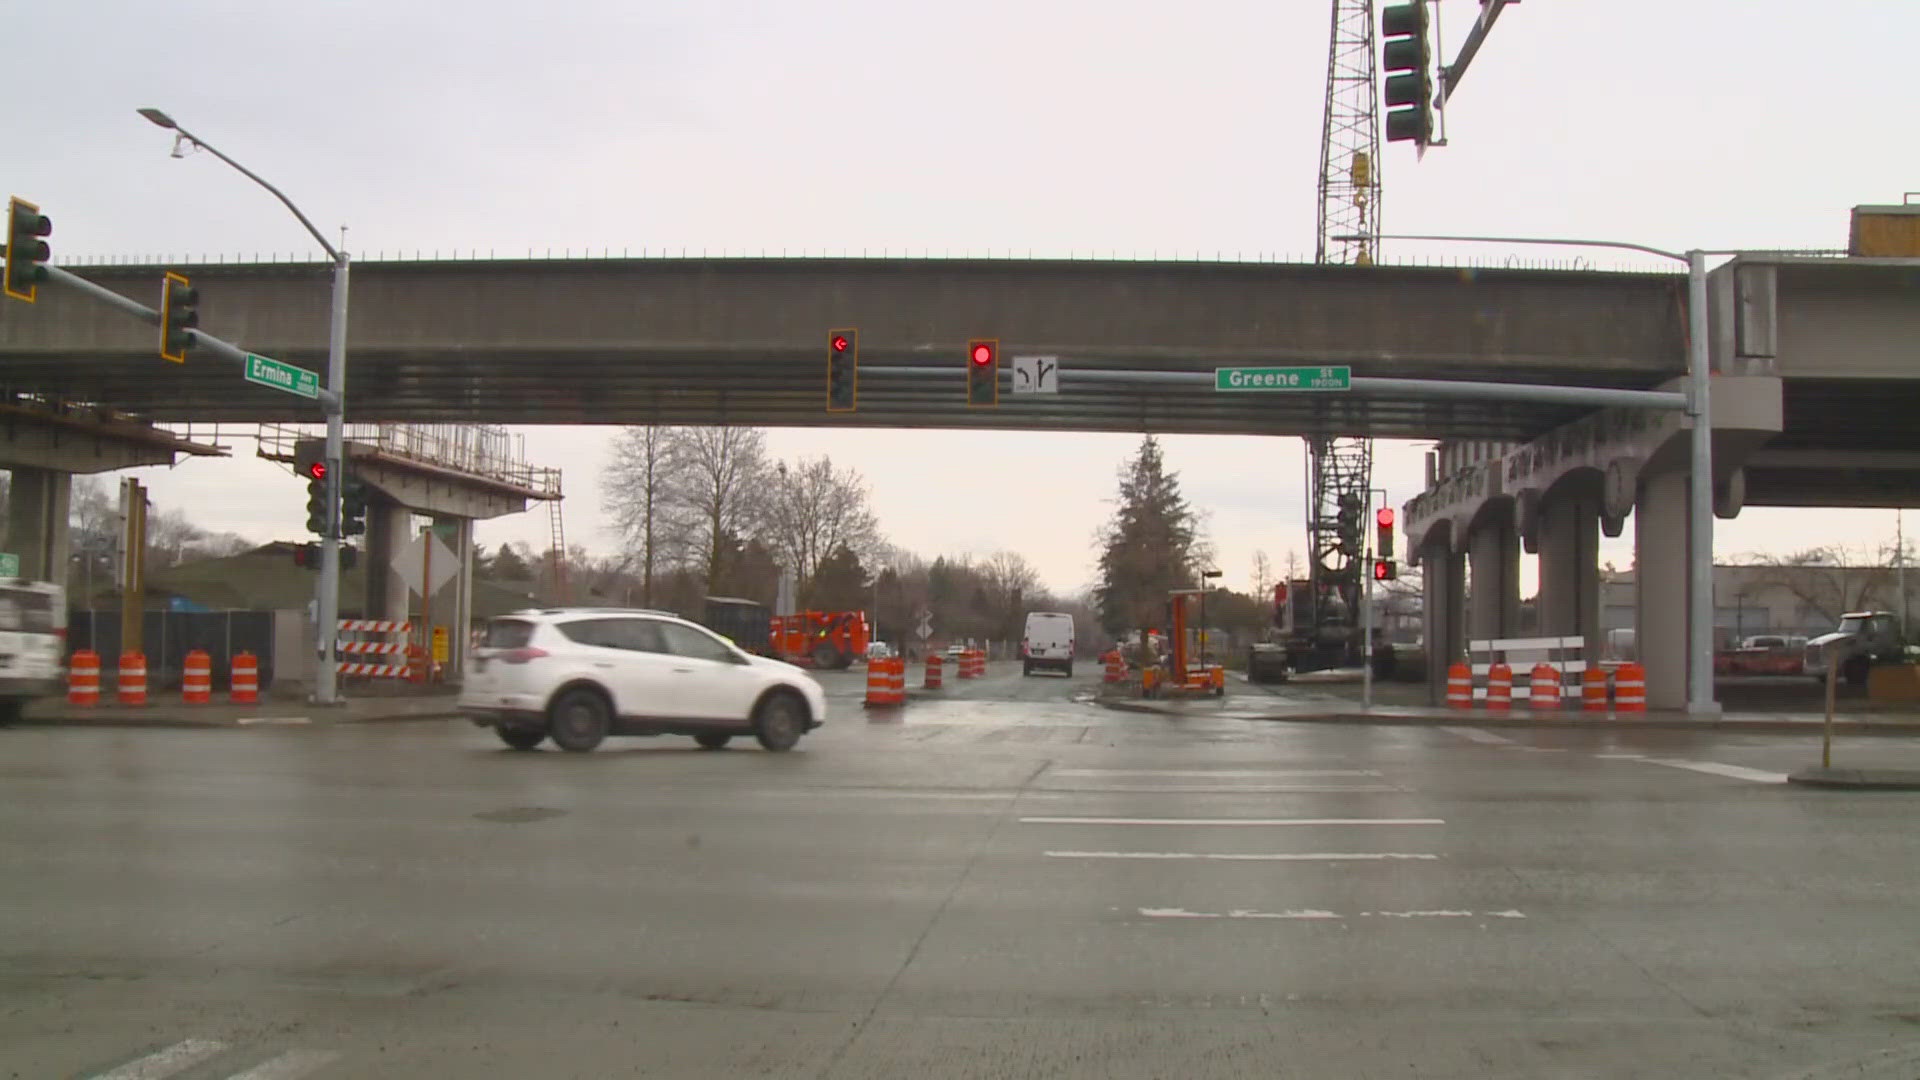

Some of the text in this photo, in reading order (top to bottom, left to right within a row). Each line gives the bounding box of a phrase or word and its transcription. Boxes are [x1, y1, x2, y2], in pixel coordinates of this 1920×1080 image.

[253, 359, 292, 385] Ermina
[1229, 371, 1300, 386] Greene
[1320, 368, 1333, 378] St
